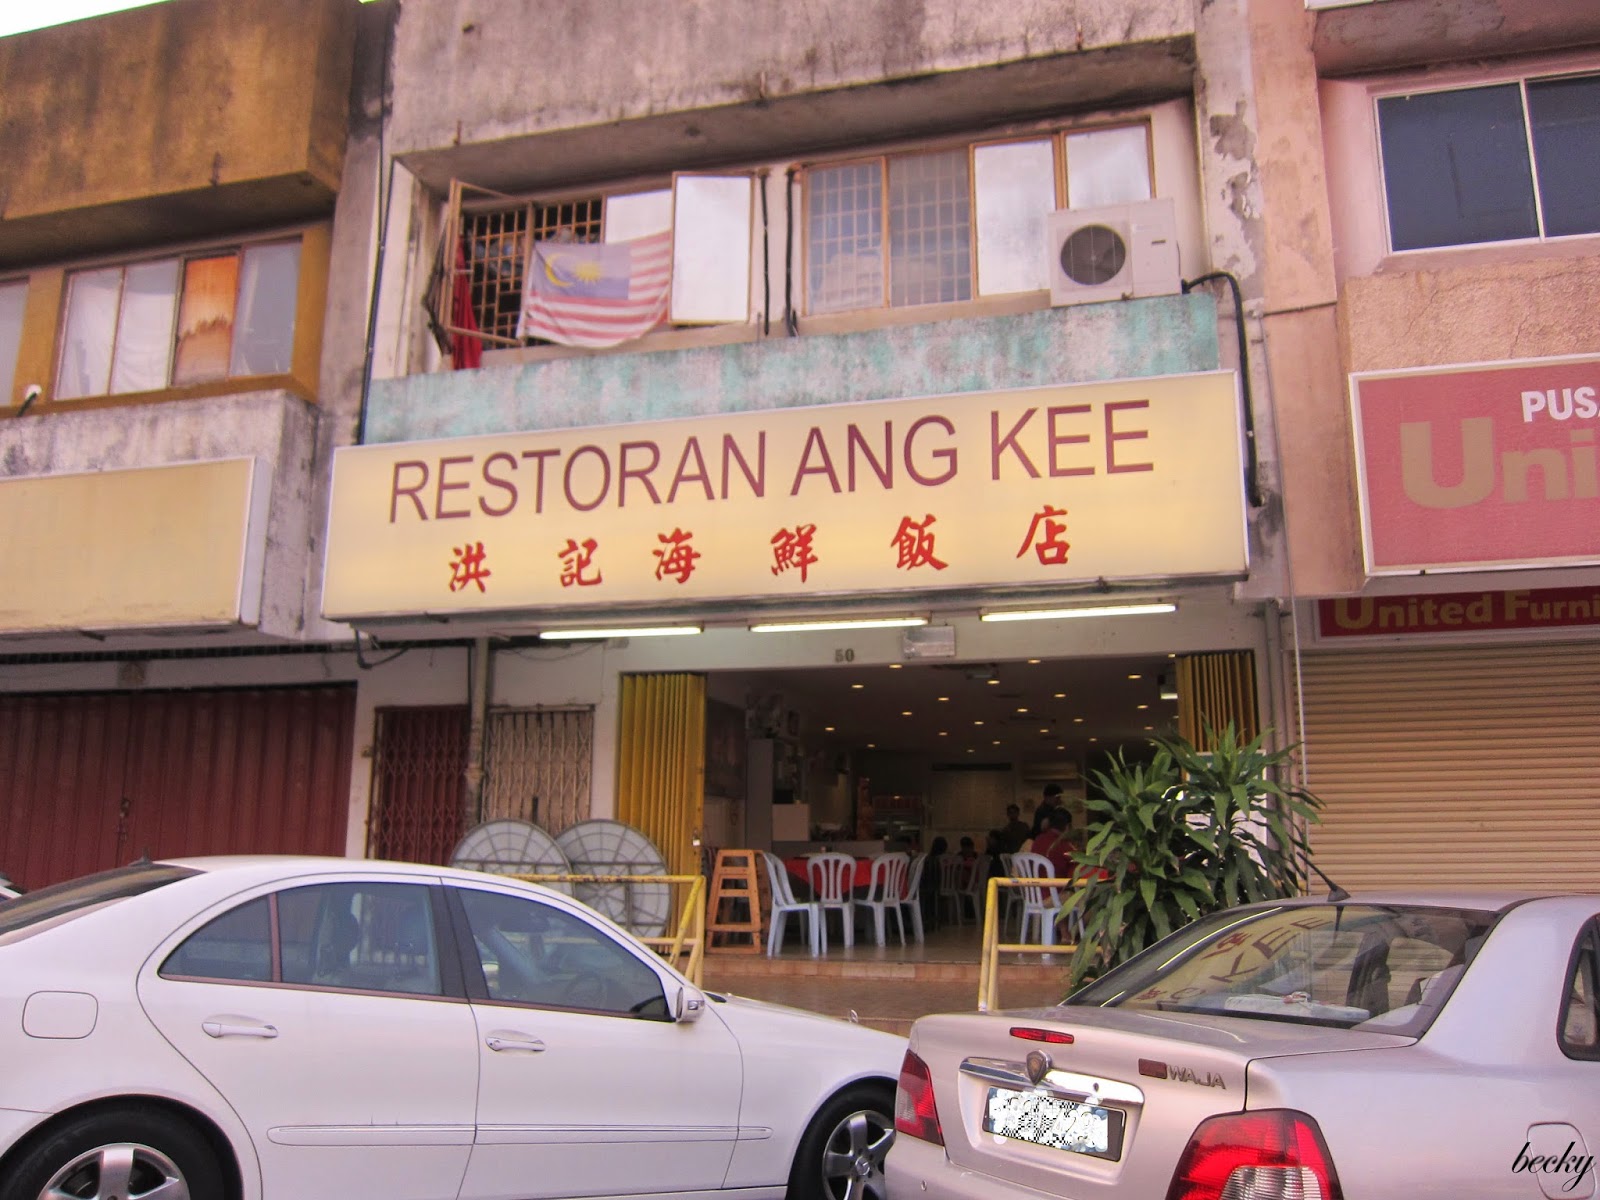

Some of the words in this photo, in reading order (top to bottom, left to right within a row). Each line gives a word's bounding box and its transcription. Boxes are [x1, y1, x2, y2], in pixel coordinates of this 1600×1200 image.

[1521, 386, 1600, 422] PUS
[390, 430, 766, 523] RESTORAN
[790, 414, 958, 496] ANG
[991, 399, 1154, 481] KEE
[1400, 417, 1600, 509] Uni
[448, 504, 1071, 593] 洪記海鮮飯店
[1335, 593, 1493, 630] United
[834, 648, 855, 662] 50
[1167, 1064, 1226, 1090] WAJA
